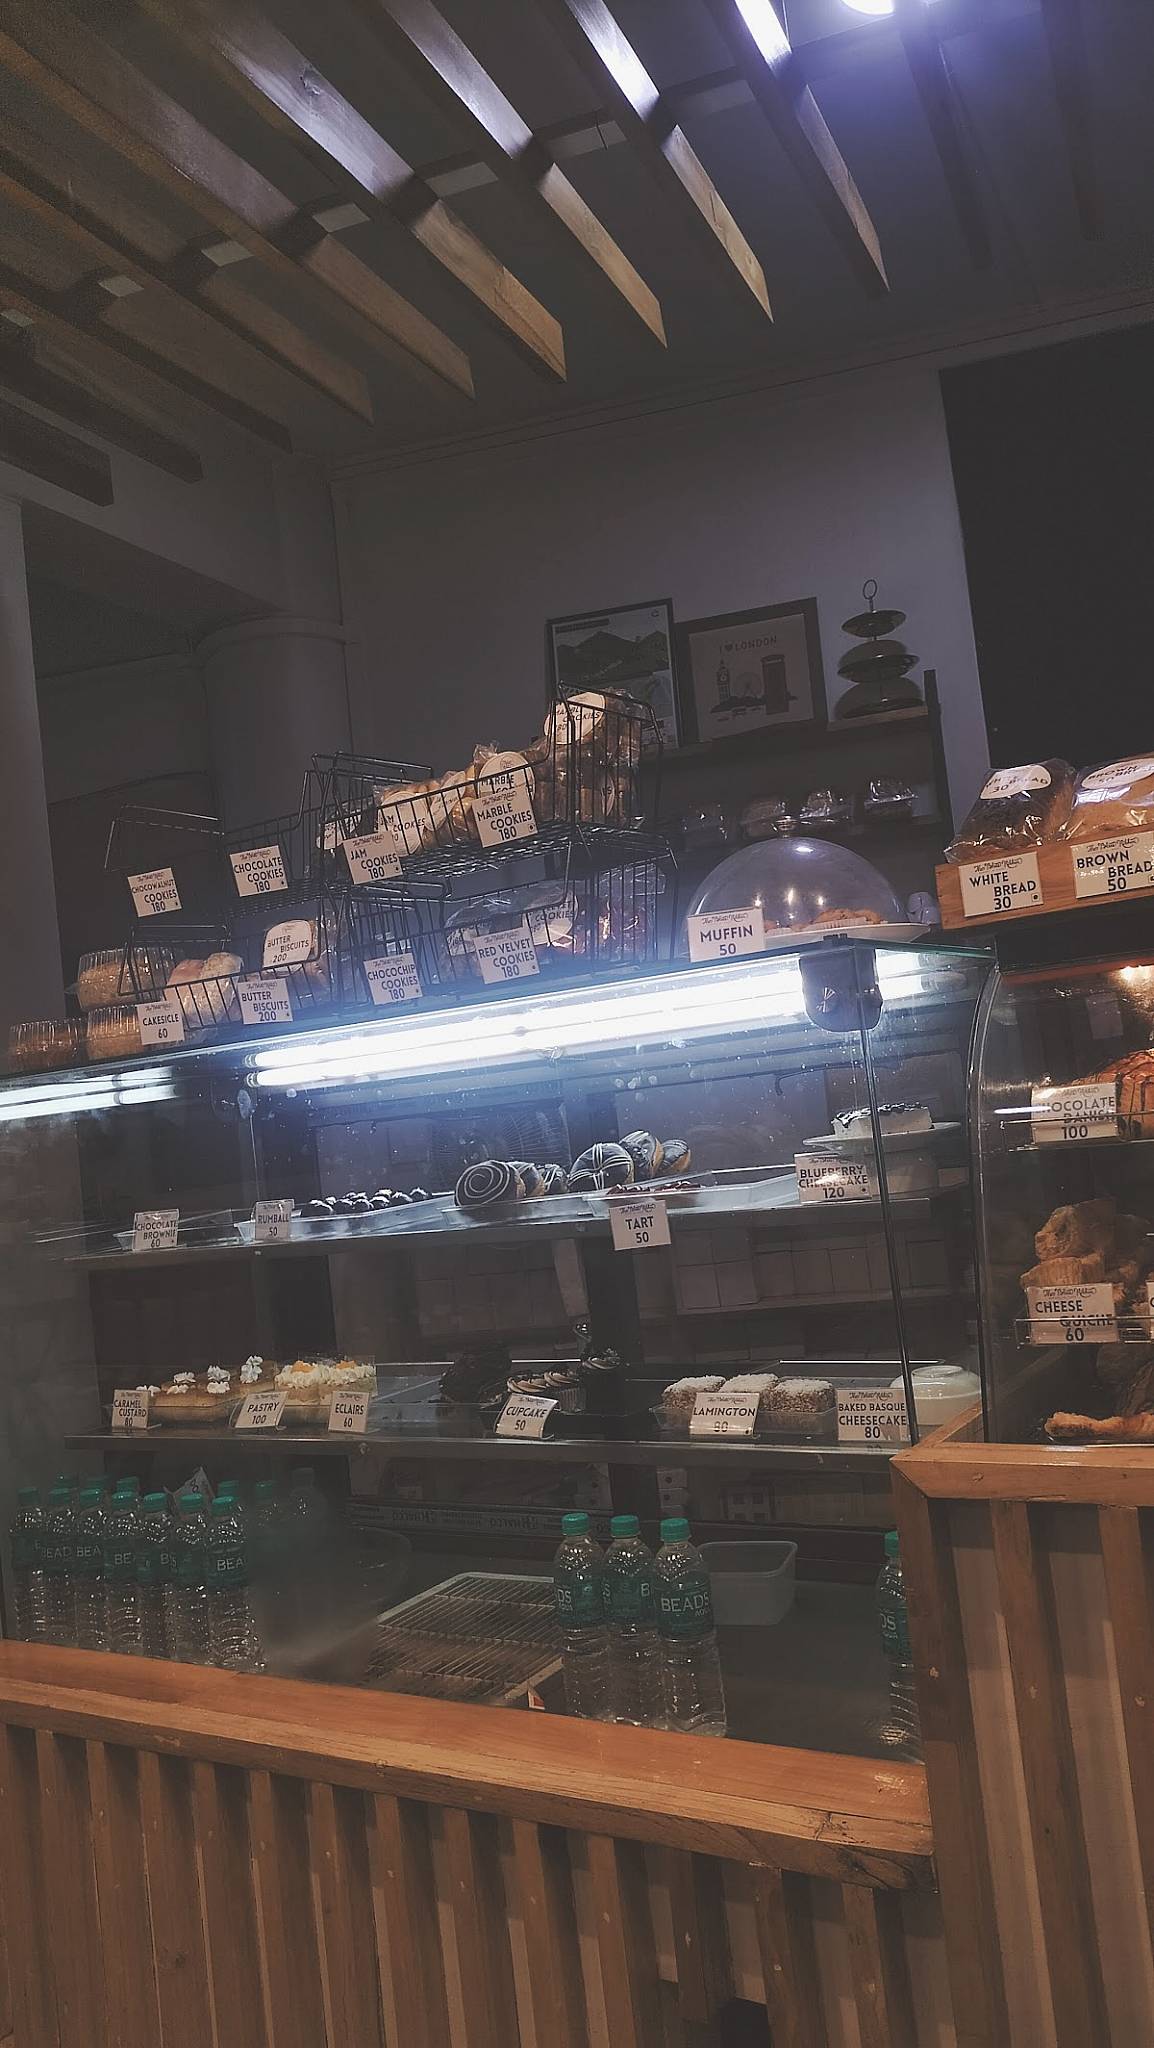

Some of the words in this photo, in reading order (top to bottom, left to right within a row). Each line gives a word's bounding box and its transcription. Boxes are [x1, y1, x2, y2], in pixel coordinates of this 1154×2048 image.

[735, 635, 777, 651] LONDON
[477, 803, 513, 822] MARBLE
[490, 810, 532, 831] COOKIES
[499, 826, 517, 841] 180
[350, 848, 367, 860] JAM
[1076, 850, 1130, 868] BROWN
[233, 856, 283, 874] CHOCOLATE
[361, 853, 398, 870] COOKIES
[247, 868, 284, 883] COOKIES
[368, 866, 385, 879] 180
[1108, 861, 1153, 878] BREAD
[969, 871, 1009, 888] WHITE
[1108, 877, 1127, 891] 50
[131, 879, 174, 894] CHOCOWALNUT
[254, 880, 270, 893] 180
[994, 880, 1036, 897] BREAD
[144, 889, 177, 904] COOKIES
[993, 896, 1011, 910] 30
[151, 901, 166, 912] 180
[700, 924, 753, 943] MUFFIN
[267, 934, 291, 948] BUTTER
[280, 939, 309, 953] BISCUITS
[478, 946, 496, 959] RED
[498, 938, 531, 954] VELVET
[720, 943, 736, 955] 50
[272, 952, 287, 963] 200
[493, 950, 535, 968] COOKIES
[367, 964, 416, 981] CHOCOCHIP
[502, 964, 520, 979] 180
[381, 976, 418, 991] COOKIES
[241, 991, 272, 1002] BUTTER
[389, 989, 405, 1000] 180
[253, 1000, 289, 1012] BISCUITS
[142, 1013, 179, 1026] CAKESICLE
[259, 1012, 277, 1021] 200
[158, 1028, 168, 1039] 60
[1036, 1096, 1115, 1114] HOCOLATE
[1061, 1125, 1088, 1139] 100
[823, 1187, 845, 1198] 120
[257, 1213, 289, 1224] RUMBALL
[625, 1216, 654, 1230] TART
[136, 1220, 177, 1231] CHOCOLATE
[269, 1226, 278, 1237] 50
[143, 1229, 176, 1240] BROWNIE
[635, 1231, 649, 1243] 50
[151, 1239, 160, 1247] 60
[1035, 1300, 1083, 1313] CHEESE
[1060, 1313, 1114, 1328] QUICHE
[1065, 1327, 1085, 1341] 60
[114, 1399, 142, 1408] CARAMEL
[247, 1402, 279, 1413] PASTRY
[335, 1403, 364, 1415] ECLAIRS
[838, 1402, 866, 1412] BAKED
[869, 1402, 906, 1412] BASQUE
[118, 1408, 147, 1417] CUSTARD
[506, 1406, 548, 1418] CUPCAKE
[693, 1407, 756, 1417] LAMINGTON
[252, 1415, 267, 1424] 100
[344, 1417, 353, 1428] 60
[514, 1420, 526, 1431] 50
[839, 1415, 907, 1426] CHEESECAKE
[864, 1426, 880, 1439] 80
